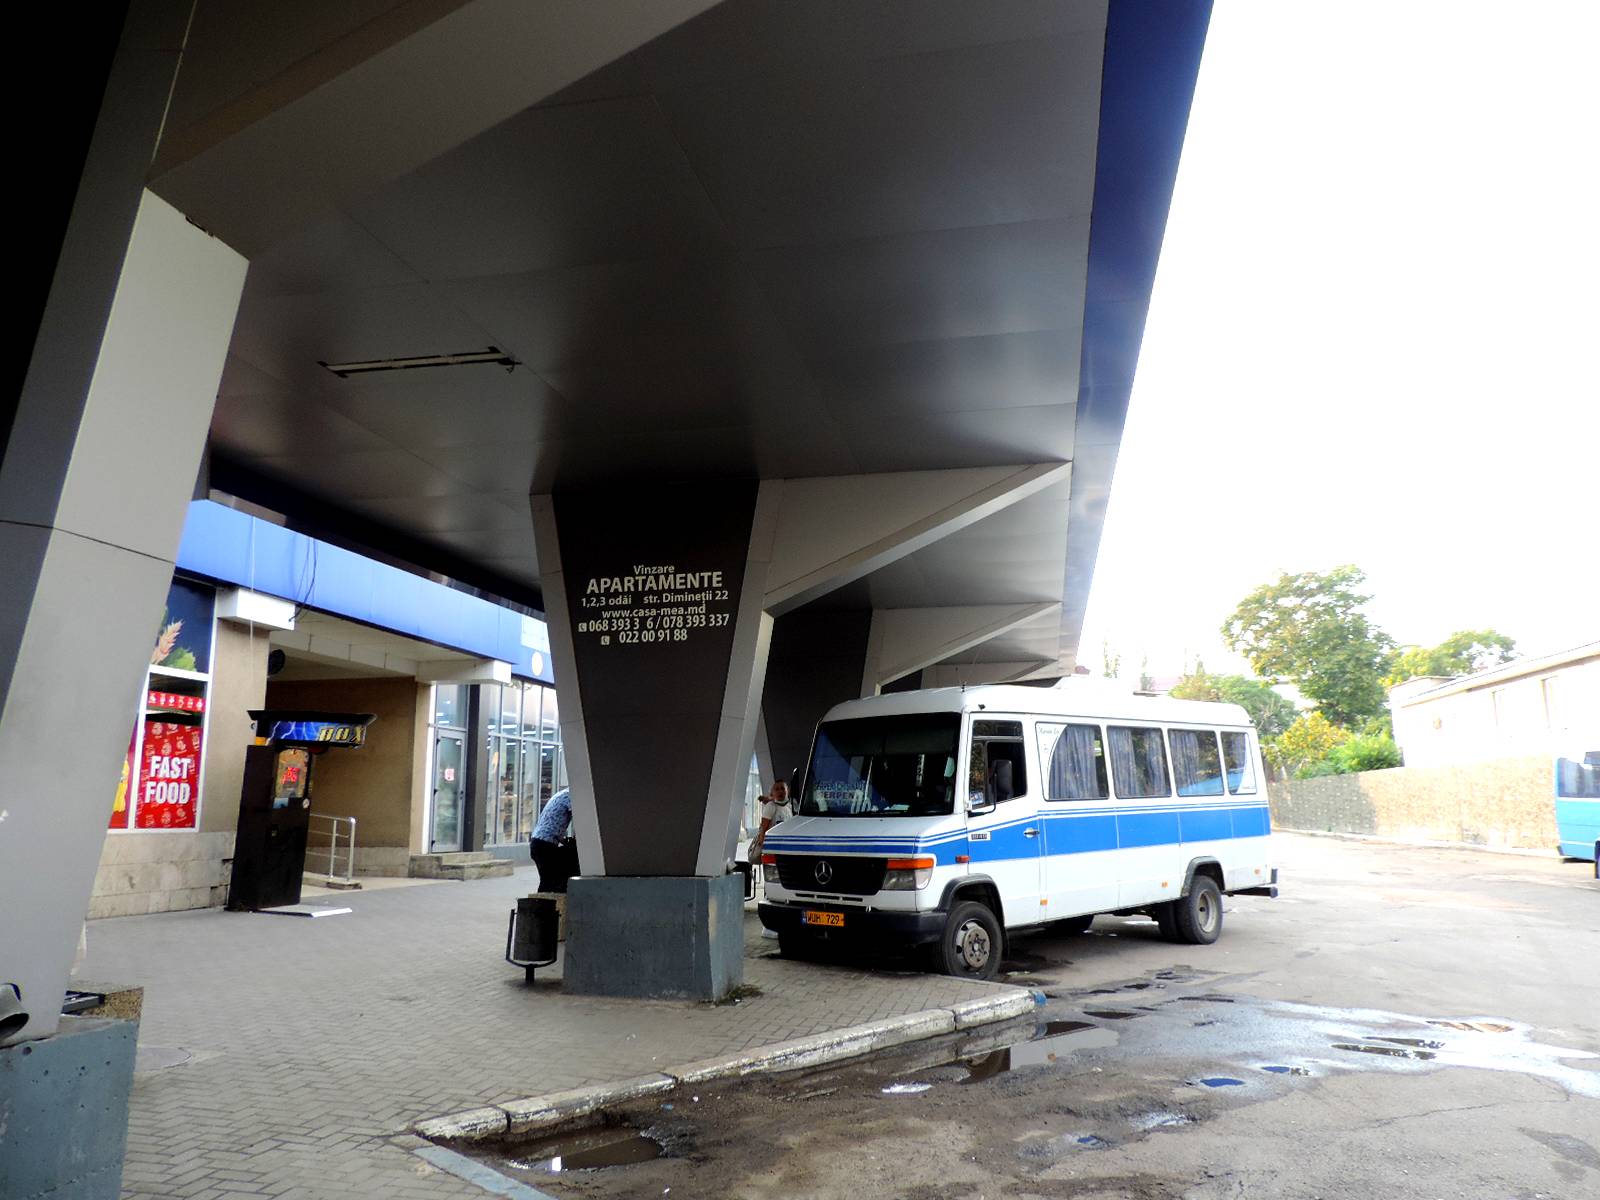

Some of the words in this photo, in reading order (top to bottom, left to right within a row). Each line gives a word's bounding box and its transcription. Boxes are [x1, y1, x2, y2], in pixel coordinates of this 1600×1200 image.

[586, 571, 722, 594] APARTAMENTE
[581, 597, 606, 608] 1,2,3
[643, 594, 660, 604] str.
[715, 590, 728, 600] 22
[602, 604, 706, 618] www.casa-mea.md
[589, 619, 609, 632] 068
[611, 618, 631, 631] 393
[663, 615, 684, 628] 078
[686, 614, 706, 628] 393
[709, 613, 730, 626] 337
[619, 631, 639, 643] 022
[642, 630, 655, 642] 00
[657, 629, 670, 642] 91
[674, 628, 688, 641] 88
[150, 755, 192, 779] FAST
[144, 781, 191, 804] FOOD
